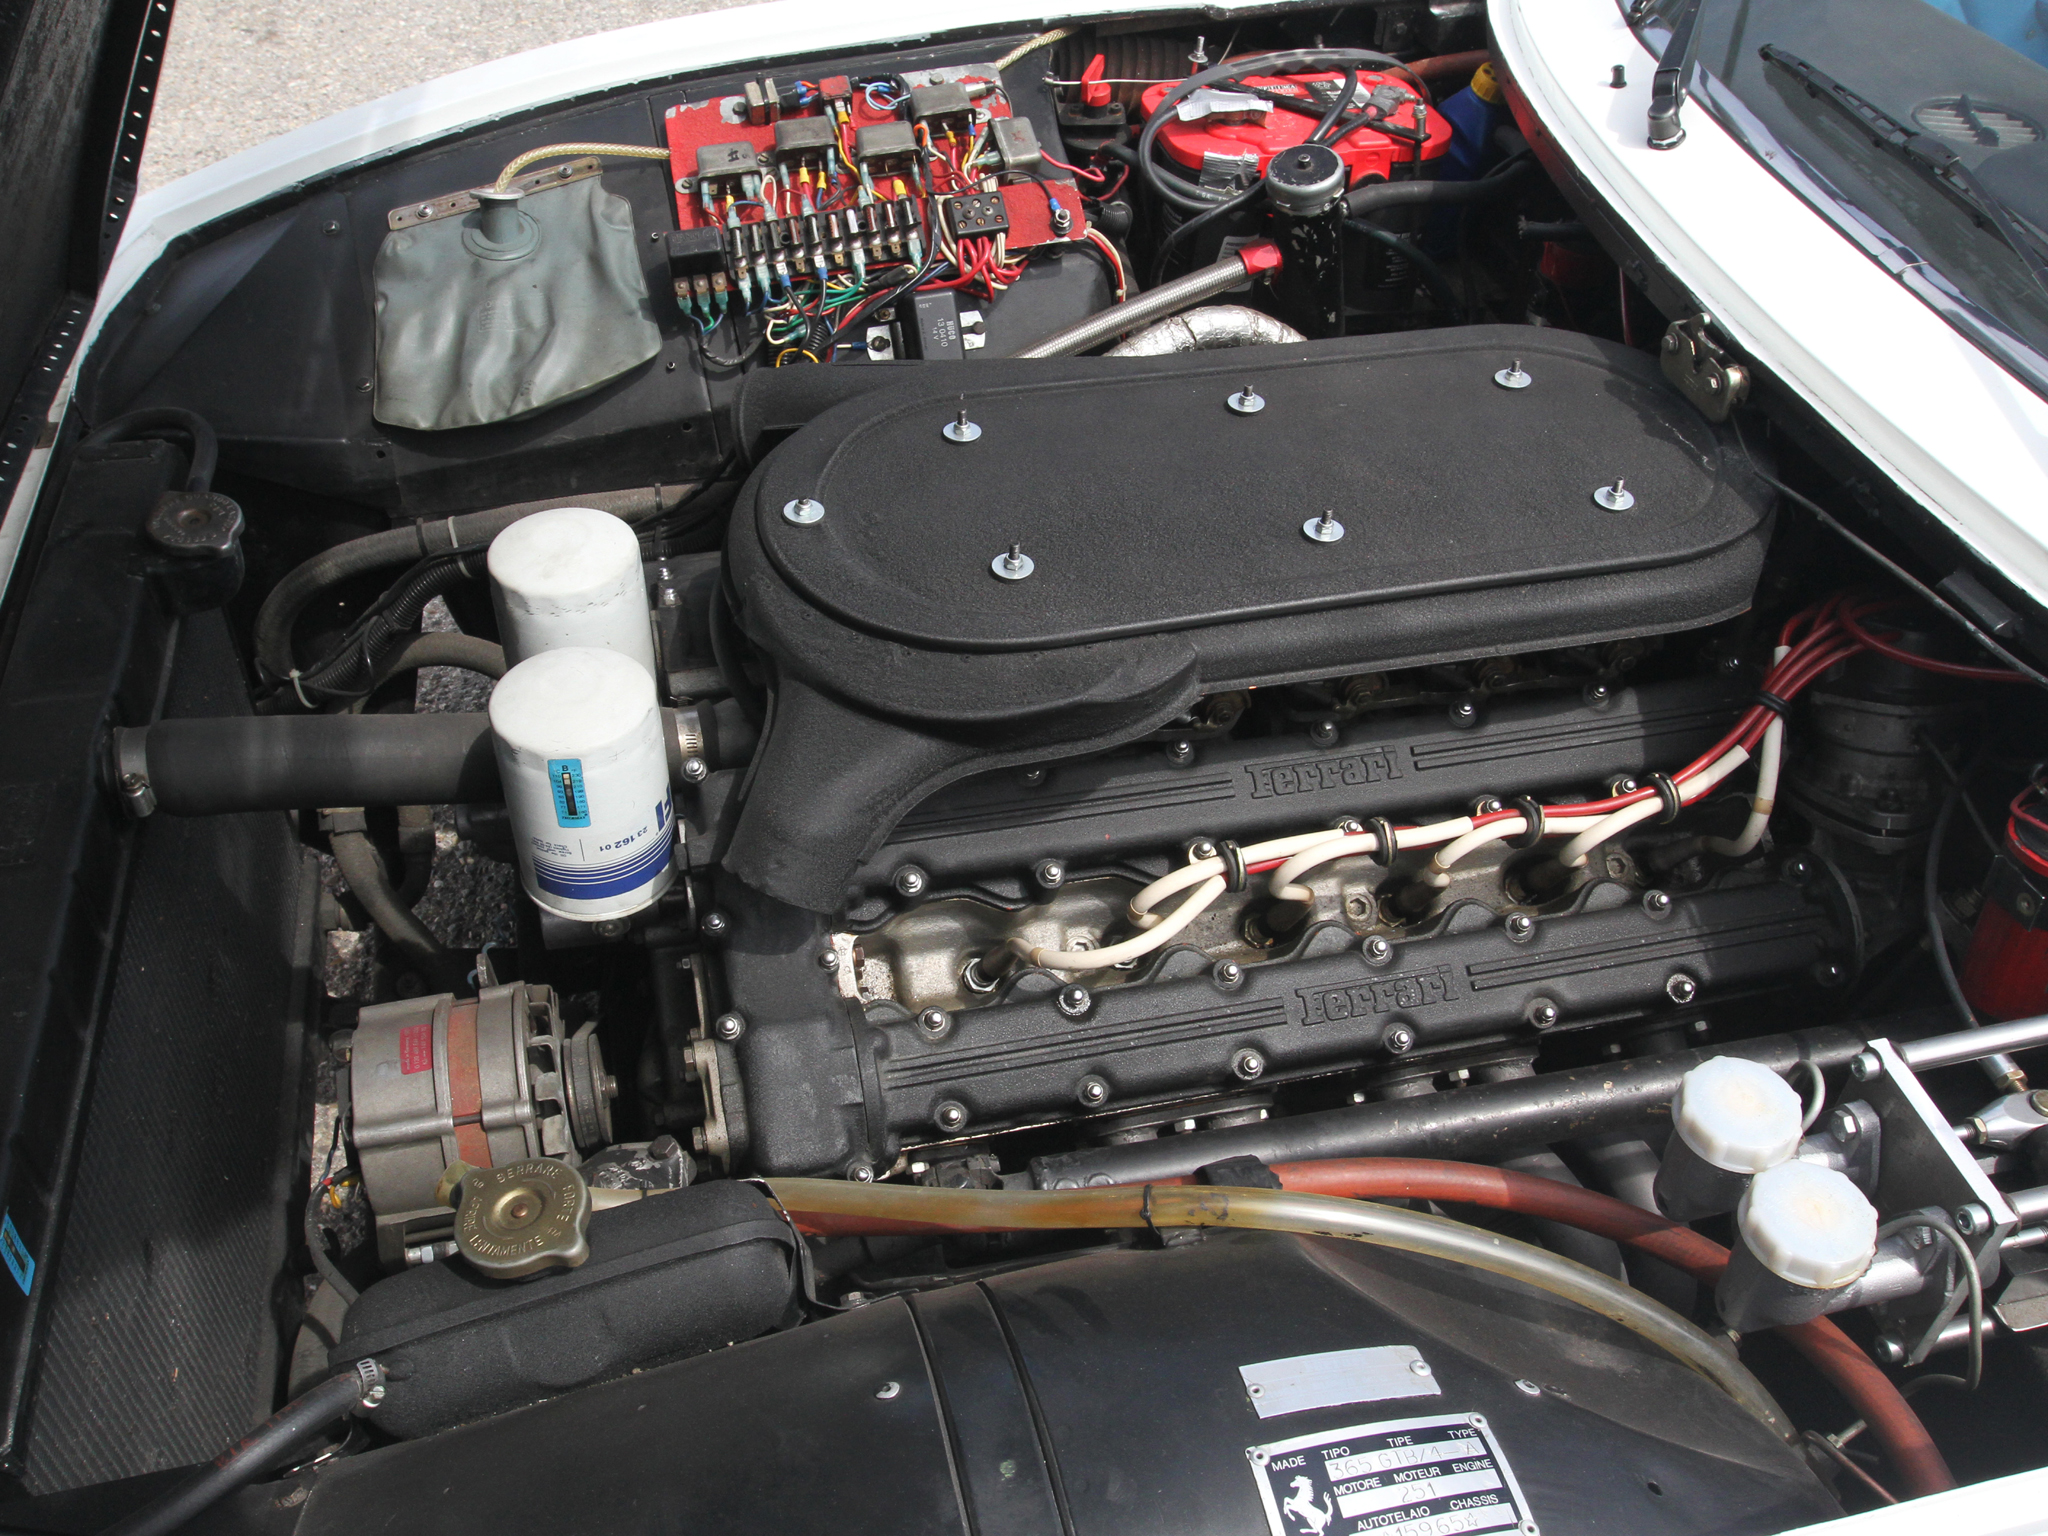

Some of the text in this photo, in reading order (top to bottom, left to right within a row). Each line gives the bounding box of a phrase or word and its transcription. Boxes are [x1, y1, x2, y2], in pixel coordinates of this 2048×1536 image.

[939, 328, 948, 347] 0410
[1244, 744, 1403, 800] Ferrari
[599, 826, 648, 852] 23 162 01
[1295, 963, 1459, 1026] Ferrari
[496, 1163, 576, 1222] SERRARE FORTE
[468, 1234, 544, 1256] LENTAMENTE
[1321, 1428, 1478, 1460] TIPO TIPE TYPE
[1271, 1455, 1306, 1472] MADE
[1333, 1458, 1493, 1496] MOTORE MOTEUR ENGINE
[1402, 1482, 1436, 1503] 251
[1357, 1493, 1499, 1532] AUTOTELAIO CHASSIS
